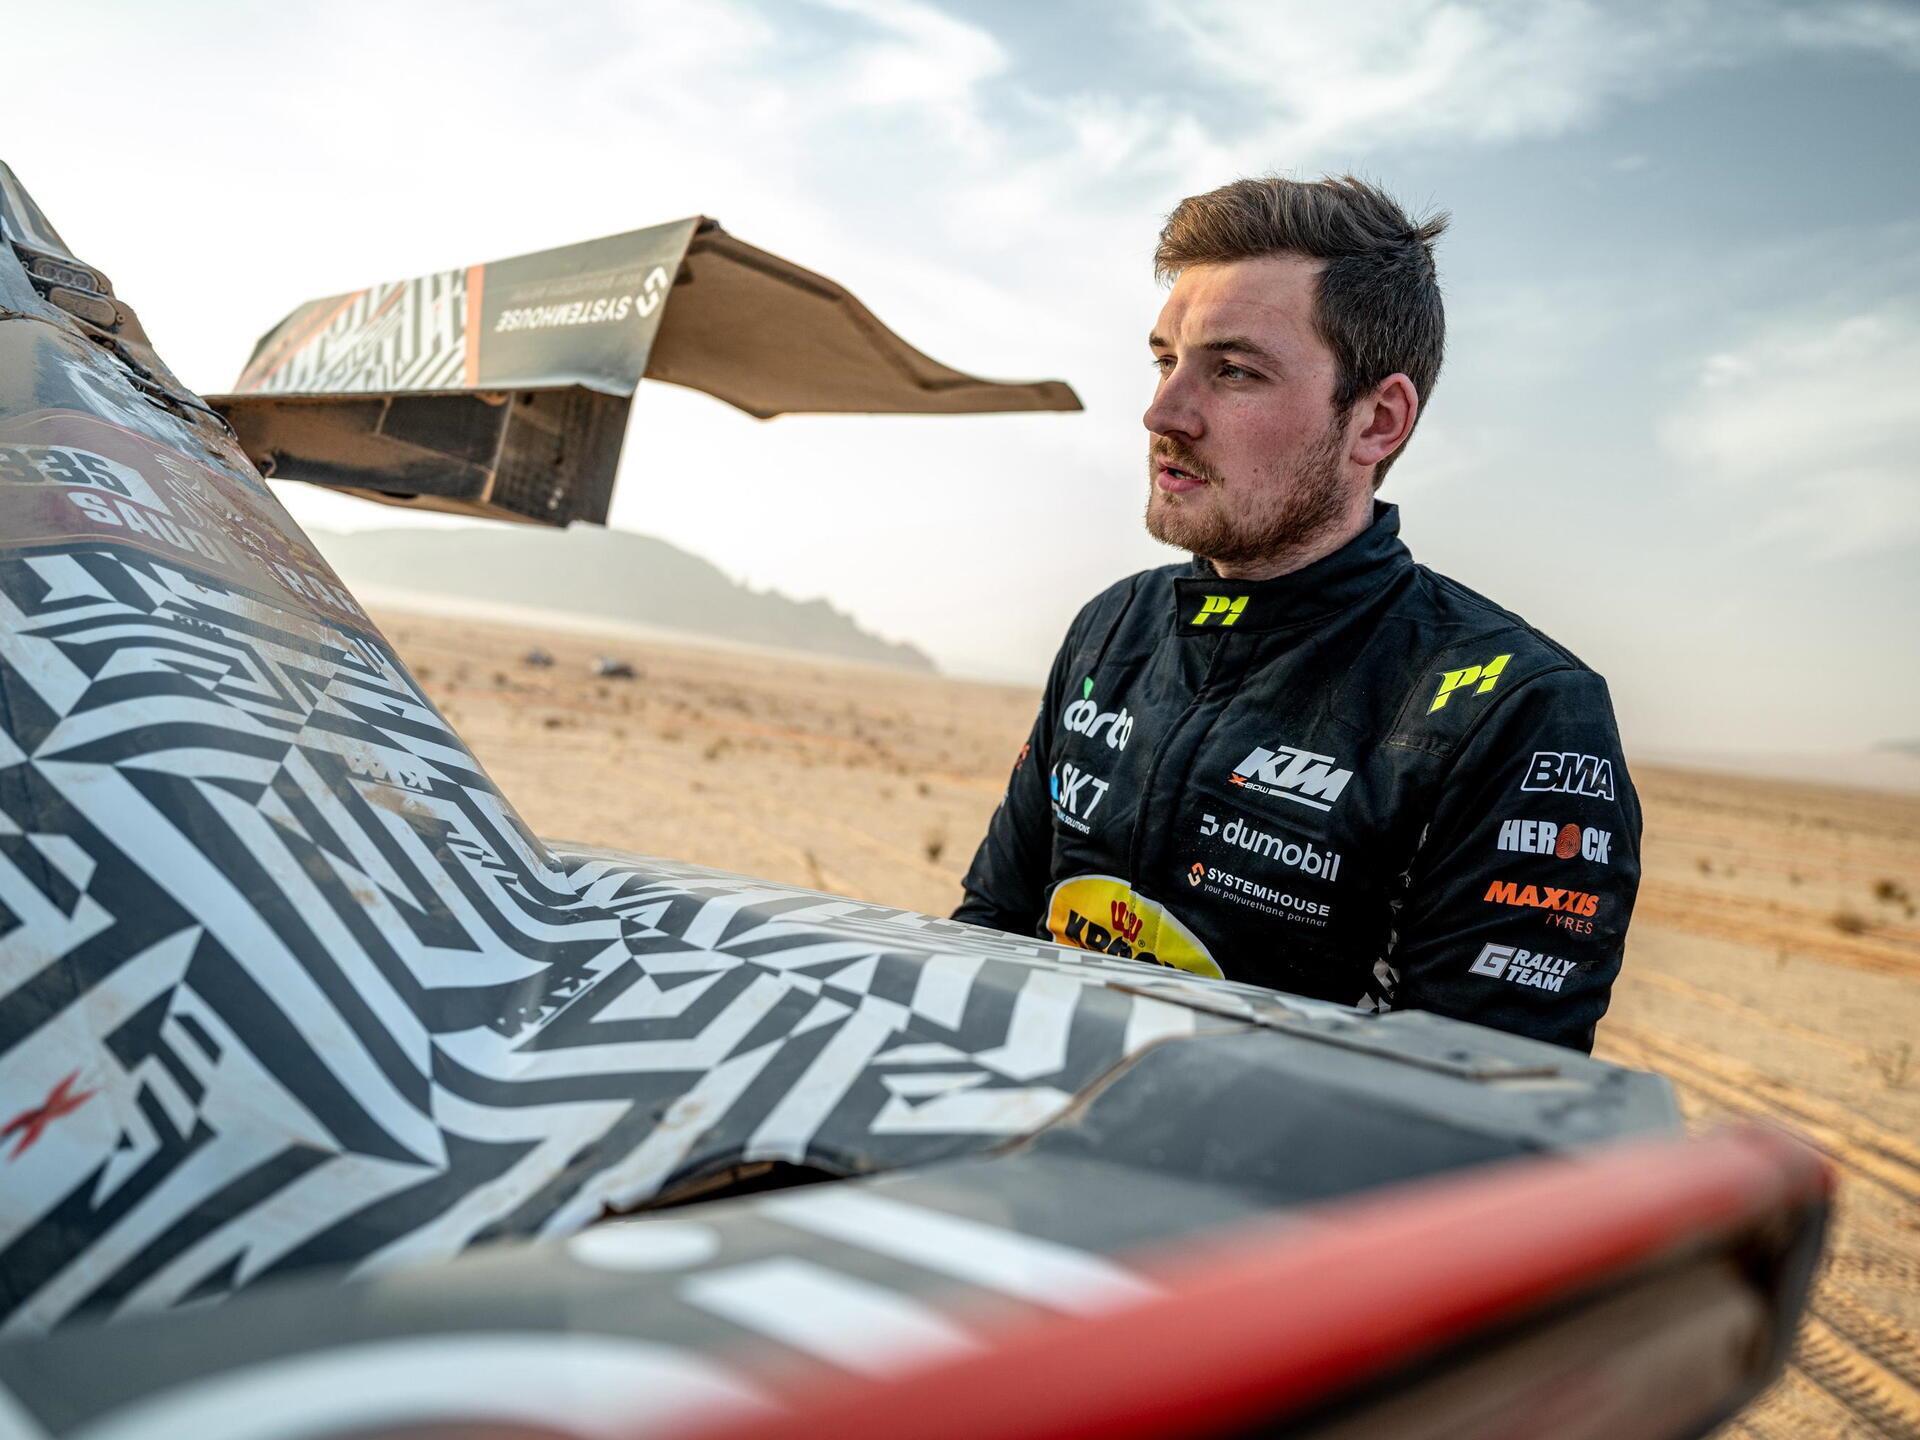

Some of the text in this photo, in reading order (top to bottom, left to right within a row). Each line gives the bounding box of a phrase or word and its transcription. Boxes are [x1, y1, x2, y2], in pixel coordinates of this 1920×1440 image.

[494, 295, 634, 333] SYSTEMHOUSE
[1190, 595, 1250, 626] P1
[1426, 653, 1514, 715] P1
[1059, 762, 1110, 820] SKT
[1232, 745, 1354, 803] KTM
[1520, 751, 1615, 801] BMA
[1222, 817, 1341, 882] dumobil
[1203, 882, 1329, 929] your polyurethane partner
[1207, 867, 1331, 918] SYSTEMHOUSE
[1483, 880, 1600, 917] MAXXIS
[1545, 913, 1594, 936] TYRES
[1506, 966, 1565, 993] TEAM
[1511, 949, 1577, 977] RALLY
